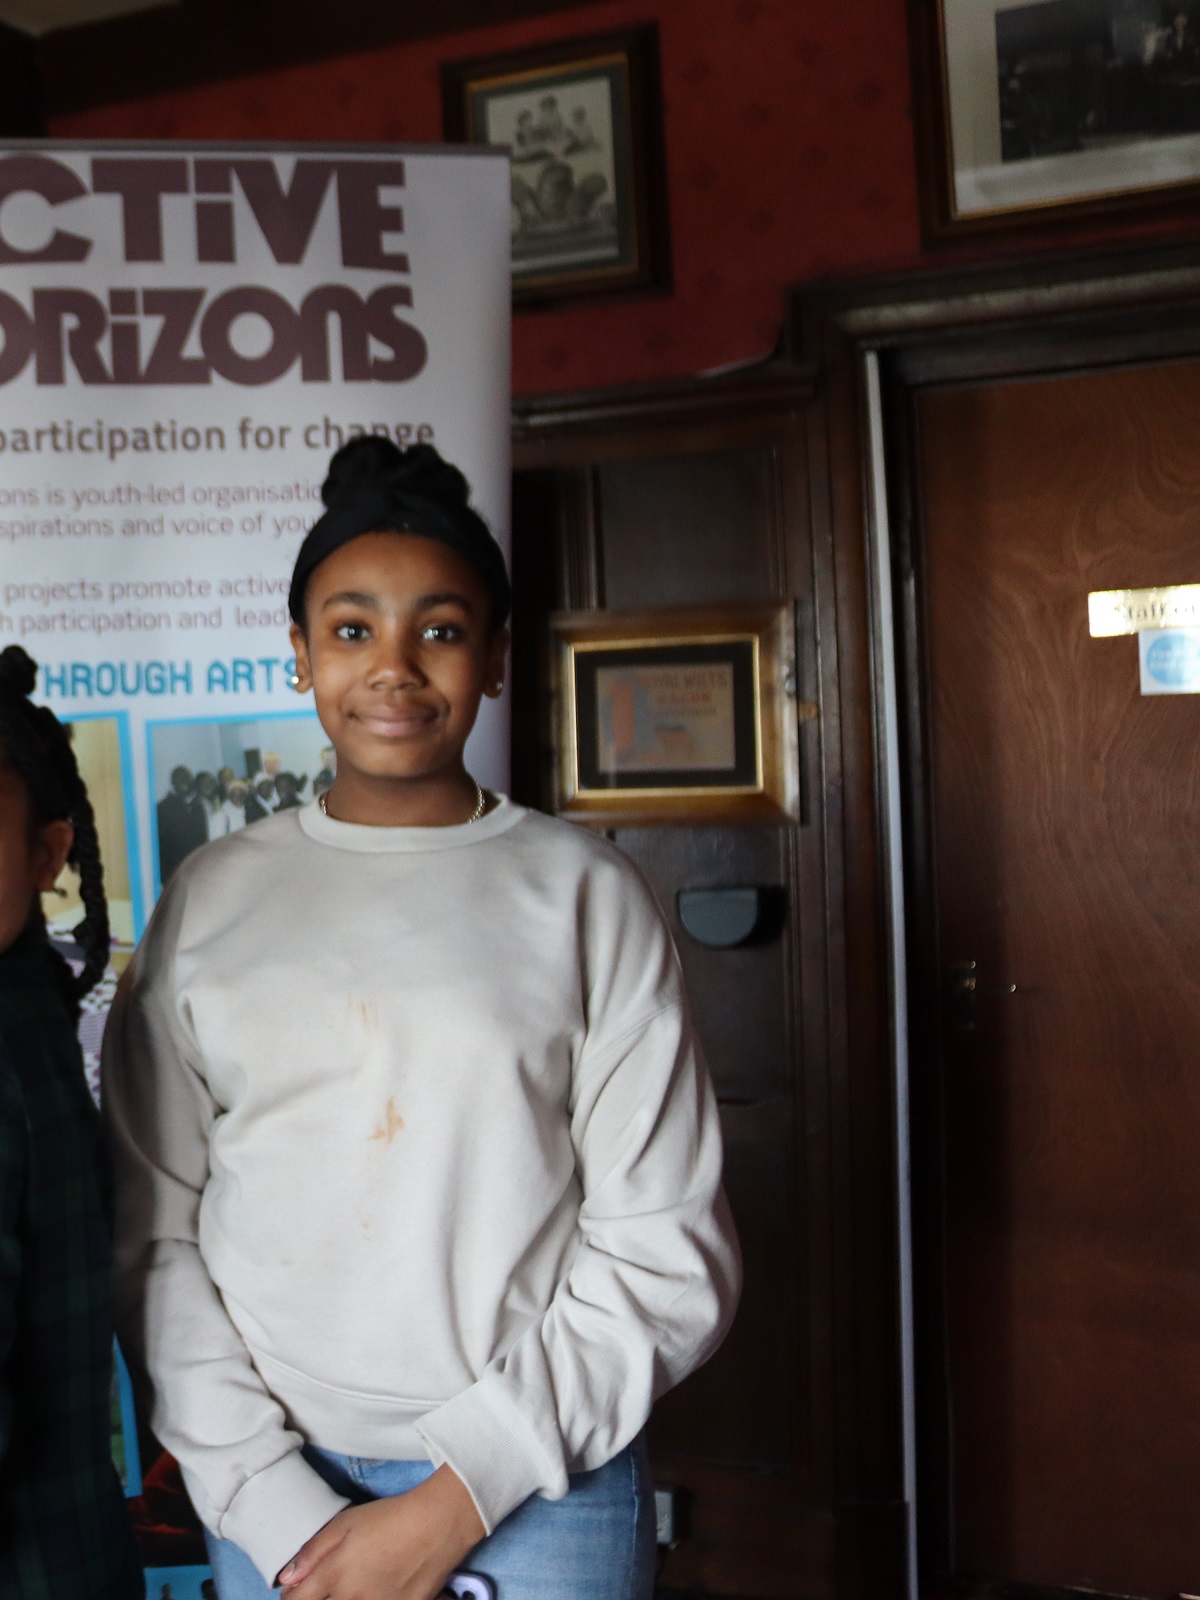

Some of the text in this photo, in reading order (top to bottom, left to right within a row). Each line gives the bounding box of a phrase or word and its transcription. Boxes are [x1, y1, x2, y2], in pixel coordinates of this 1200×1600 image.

[238, 417, 291, 450] for
[47, 482, 66, 506] is
[72, 481, 185, 511] youth-led
[193, 480, 322, 509] organisatio
[121, 514, 164, 538] and
[173, 512, 234, 536] voice
[242, 511, 265, 534] of
[273, 514, 318, 540] you
[4, 576, 103, 606] projects
[109, 576, 211, 604] promote
[218, 573, 292, 596] active
[19, 606, 171, 636] participation
[178, 604, 222, 629] and
[235, 604, 290, 628] lead
